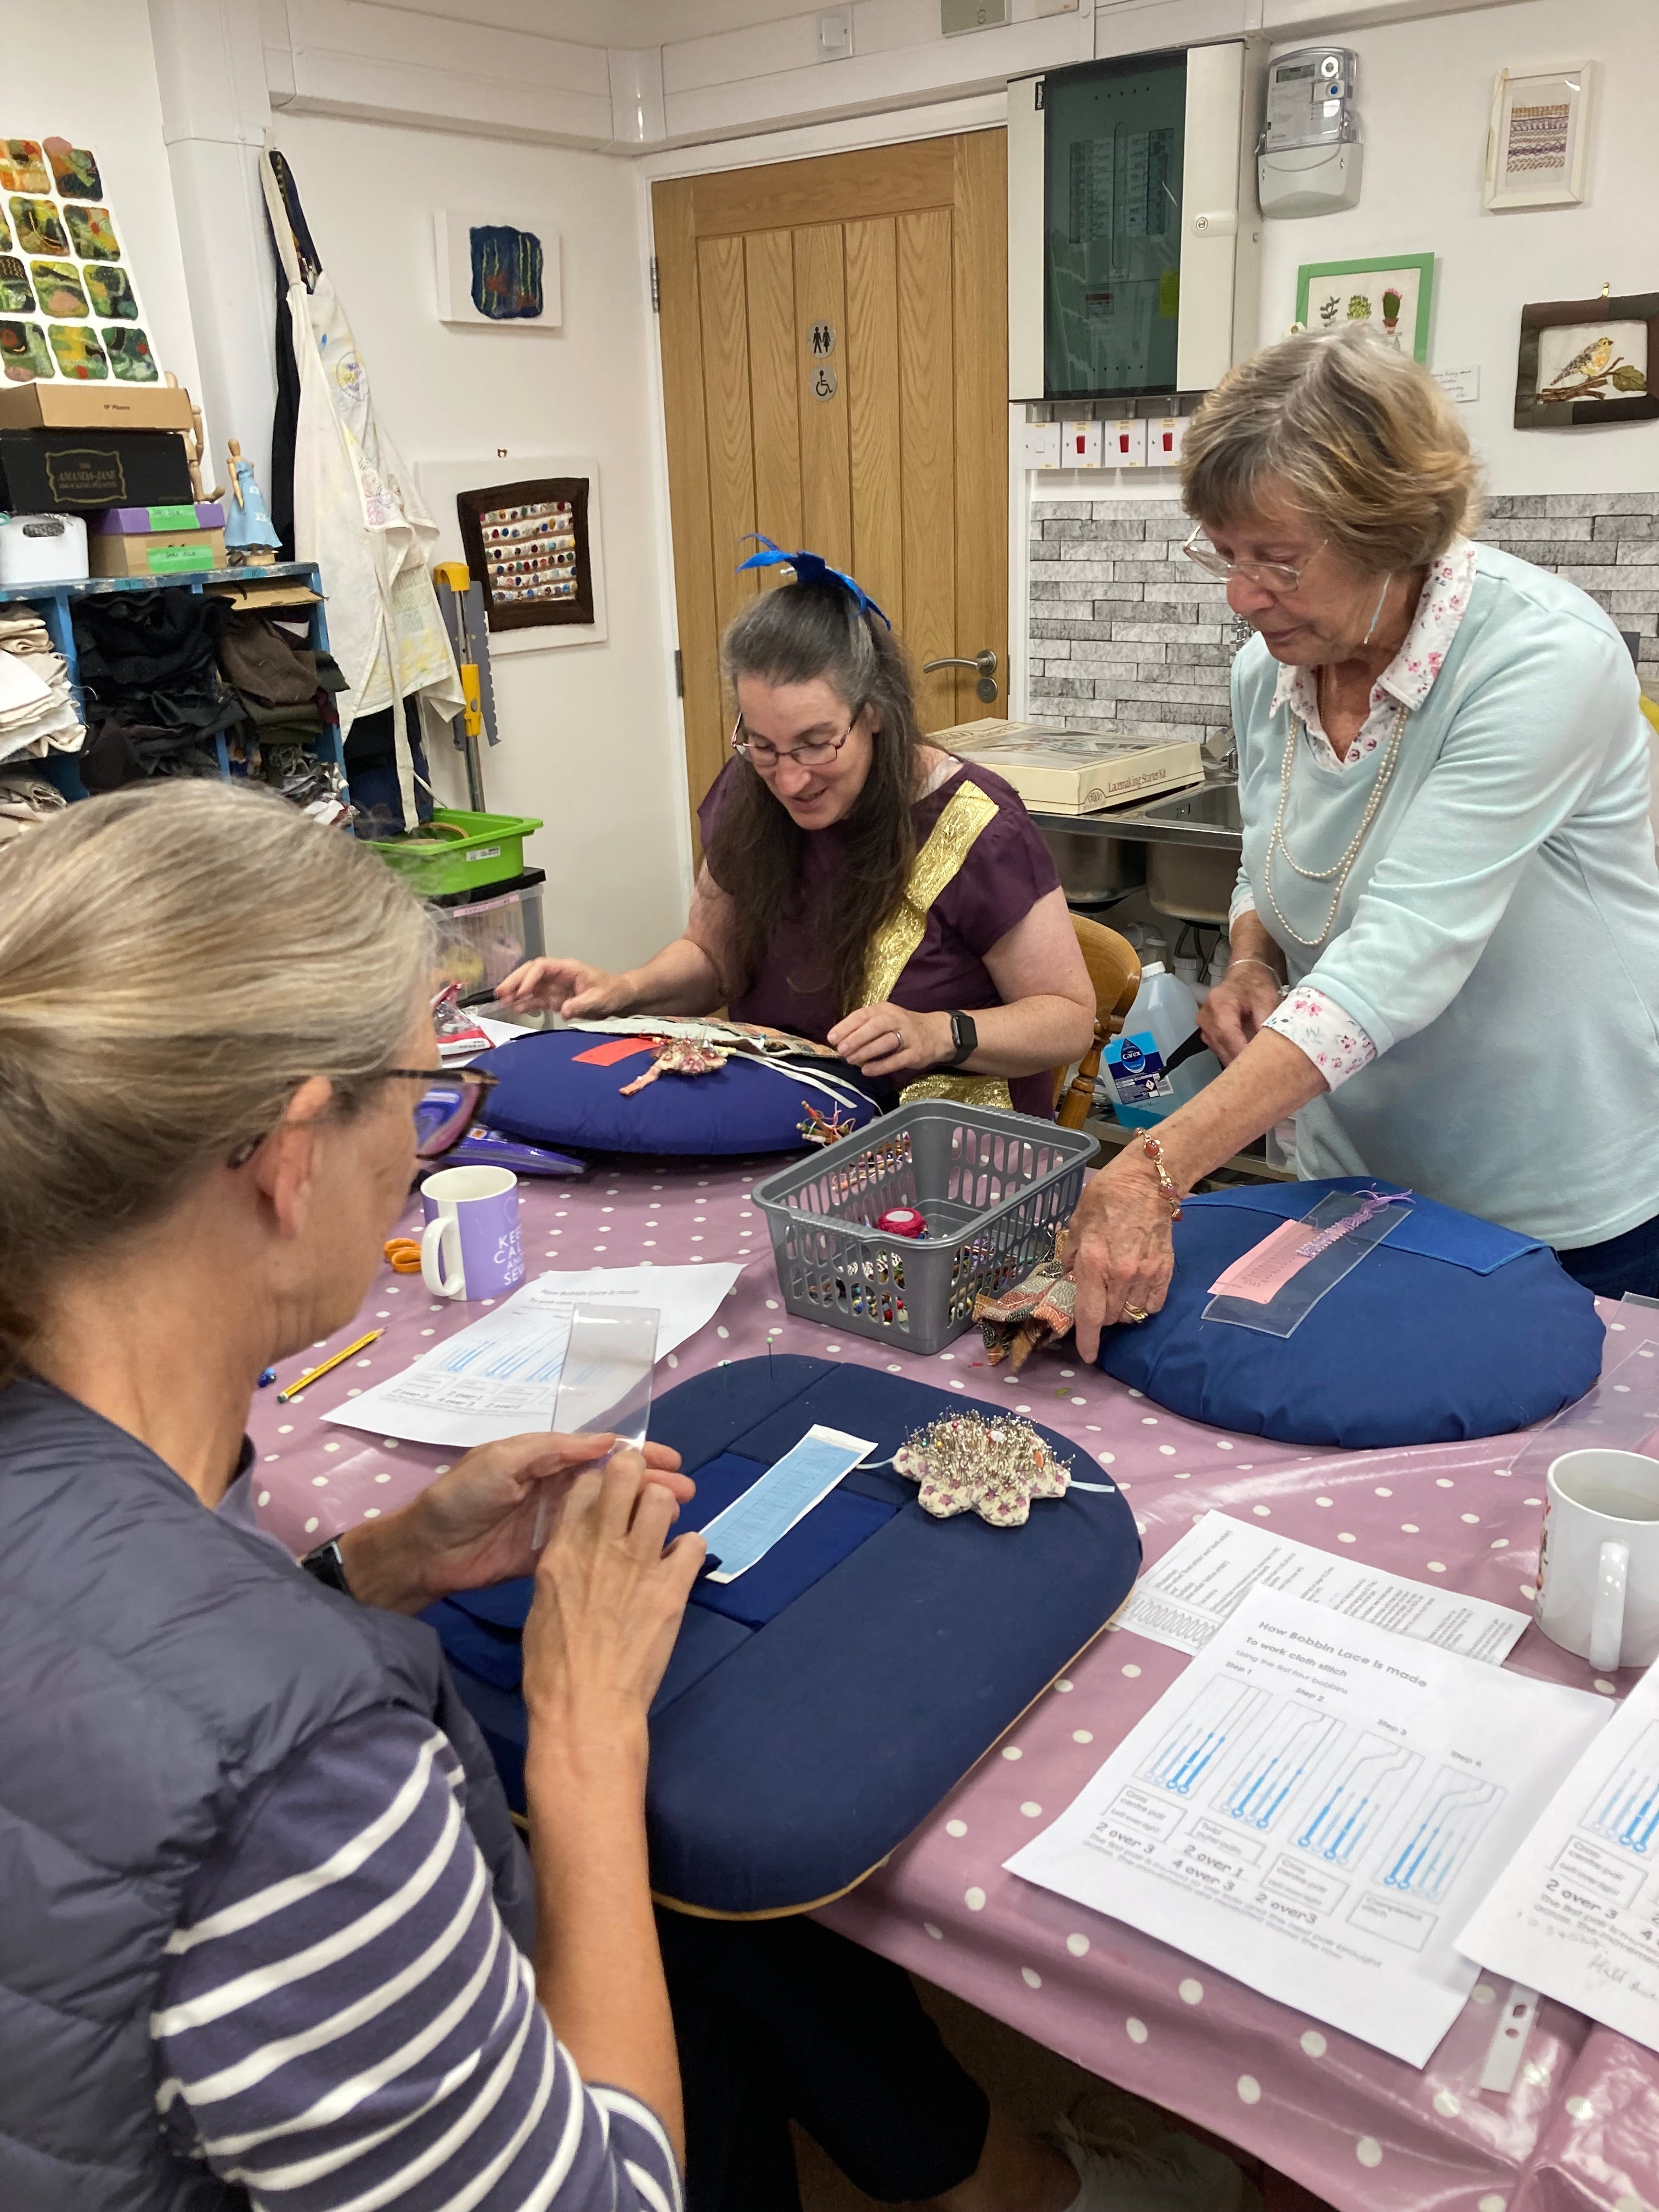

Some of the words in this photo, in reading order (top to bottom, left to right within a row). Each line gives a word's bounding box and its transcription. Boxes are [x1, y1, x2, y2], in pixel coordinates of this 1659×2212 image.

[1108, 776, 1142, 793] Lacemaking
[1142, 771, 1159, 783] Starter
[1122, 1051, 1141, 1059] Carex
[499, 1223, 522, 1249] KEE
[494, 1242, 522, 1264] CAL
[1224, 1661, 1245, 1672] Step
[1245, 1636, 1258, 1646] To
[1261, 1643, 1288, 1656] work
[1289, 1652, 1317, 1667] cloth
[1318, 1663, 1348, 1677] stitch
[1258, 1621, 1288, 1636] How
[1289, 1632, 1335, 1654] Bobbin
[1337, 1649, 1370, 1665] Lace
[1373, 1659, 1384, 1669] is
[1386, 1666, 1427, 1688] made
[1260, 1658, 1275, 1668] the
[1312, 1676, 1348, 1695] bobbins
[1295, 1688, 1316, 1700] Step
[1377, 1718, 1399, 1733] Step
[1450, 1750, 1473, 1764] Step
[1096, 1821, 1108, 1832] 2
[1109, 1830, 1142, 1847] over
[1143, 1843, 1155, 1854] 3
[1183, 1844, 1197, 1857] 2
[1197, 1853, 1232, 1871] over
[1234, 1867, 1244, 1878] 1
[1172, 1859, 1183, 1869] 4
[1185, 1866, 1221, 1884] over
[1223, 1880, 1235, 1892] 3
[1255, 1893, 1268, 1904] 2
[1365, 1896, 1423, 1922] Completed
[1545, 1878, 1560, 1892] 2
[1561, 1889, 1602, 1910] over
[1604, 1909, 1618, 1920] 3
[1641, 1929, 1654, 1941] 4
